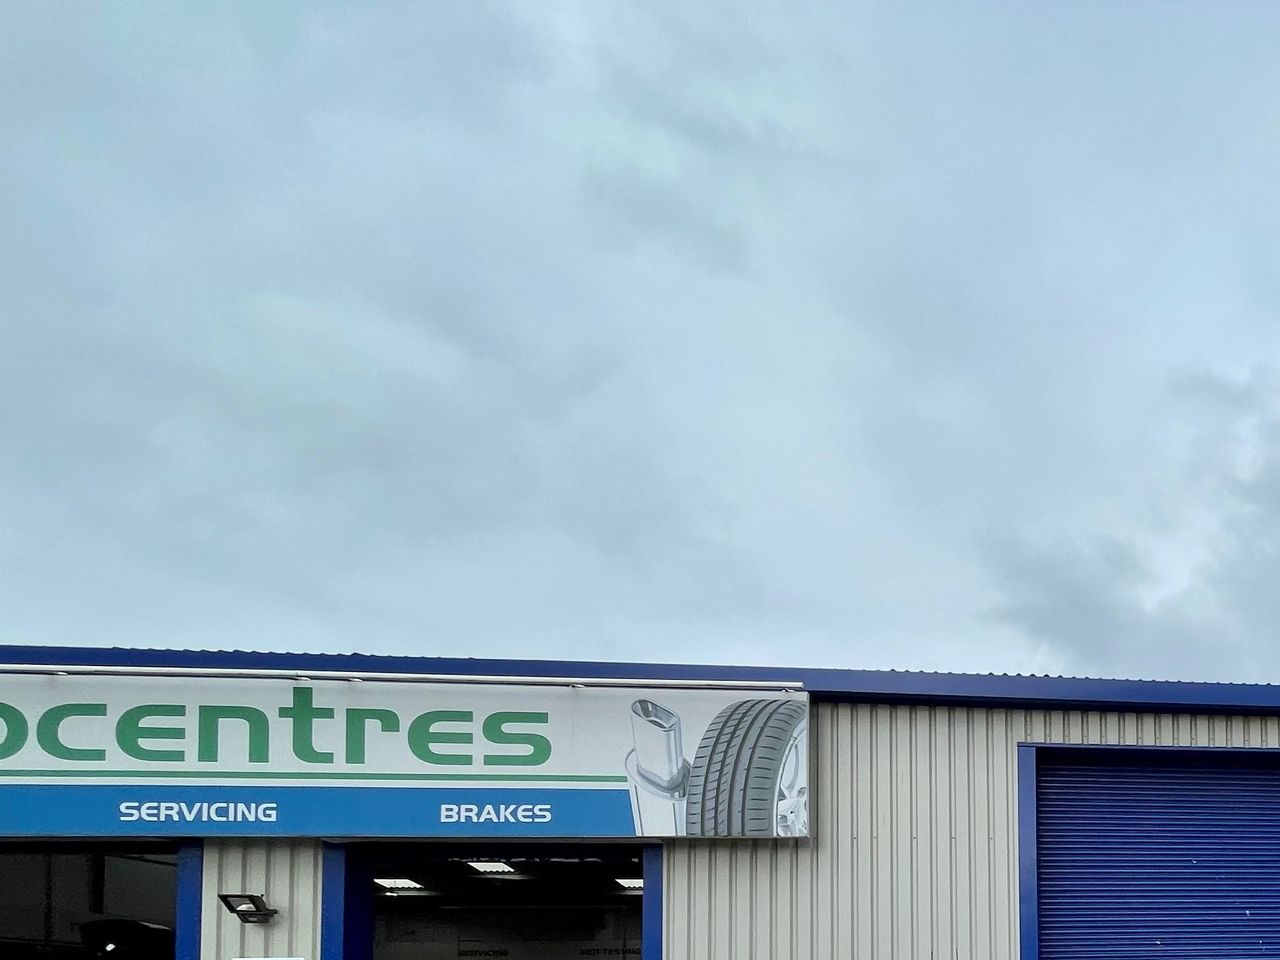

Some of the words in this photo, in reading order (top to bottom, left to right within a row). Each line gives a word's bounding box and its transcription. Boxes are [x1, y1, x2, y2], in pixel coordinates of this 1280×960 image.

[119, 802, 277, 822] SERVICING
[440, 804, 552, 823] BRAKES
[458, 949, 509, 957] SERVICING
